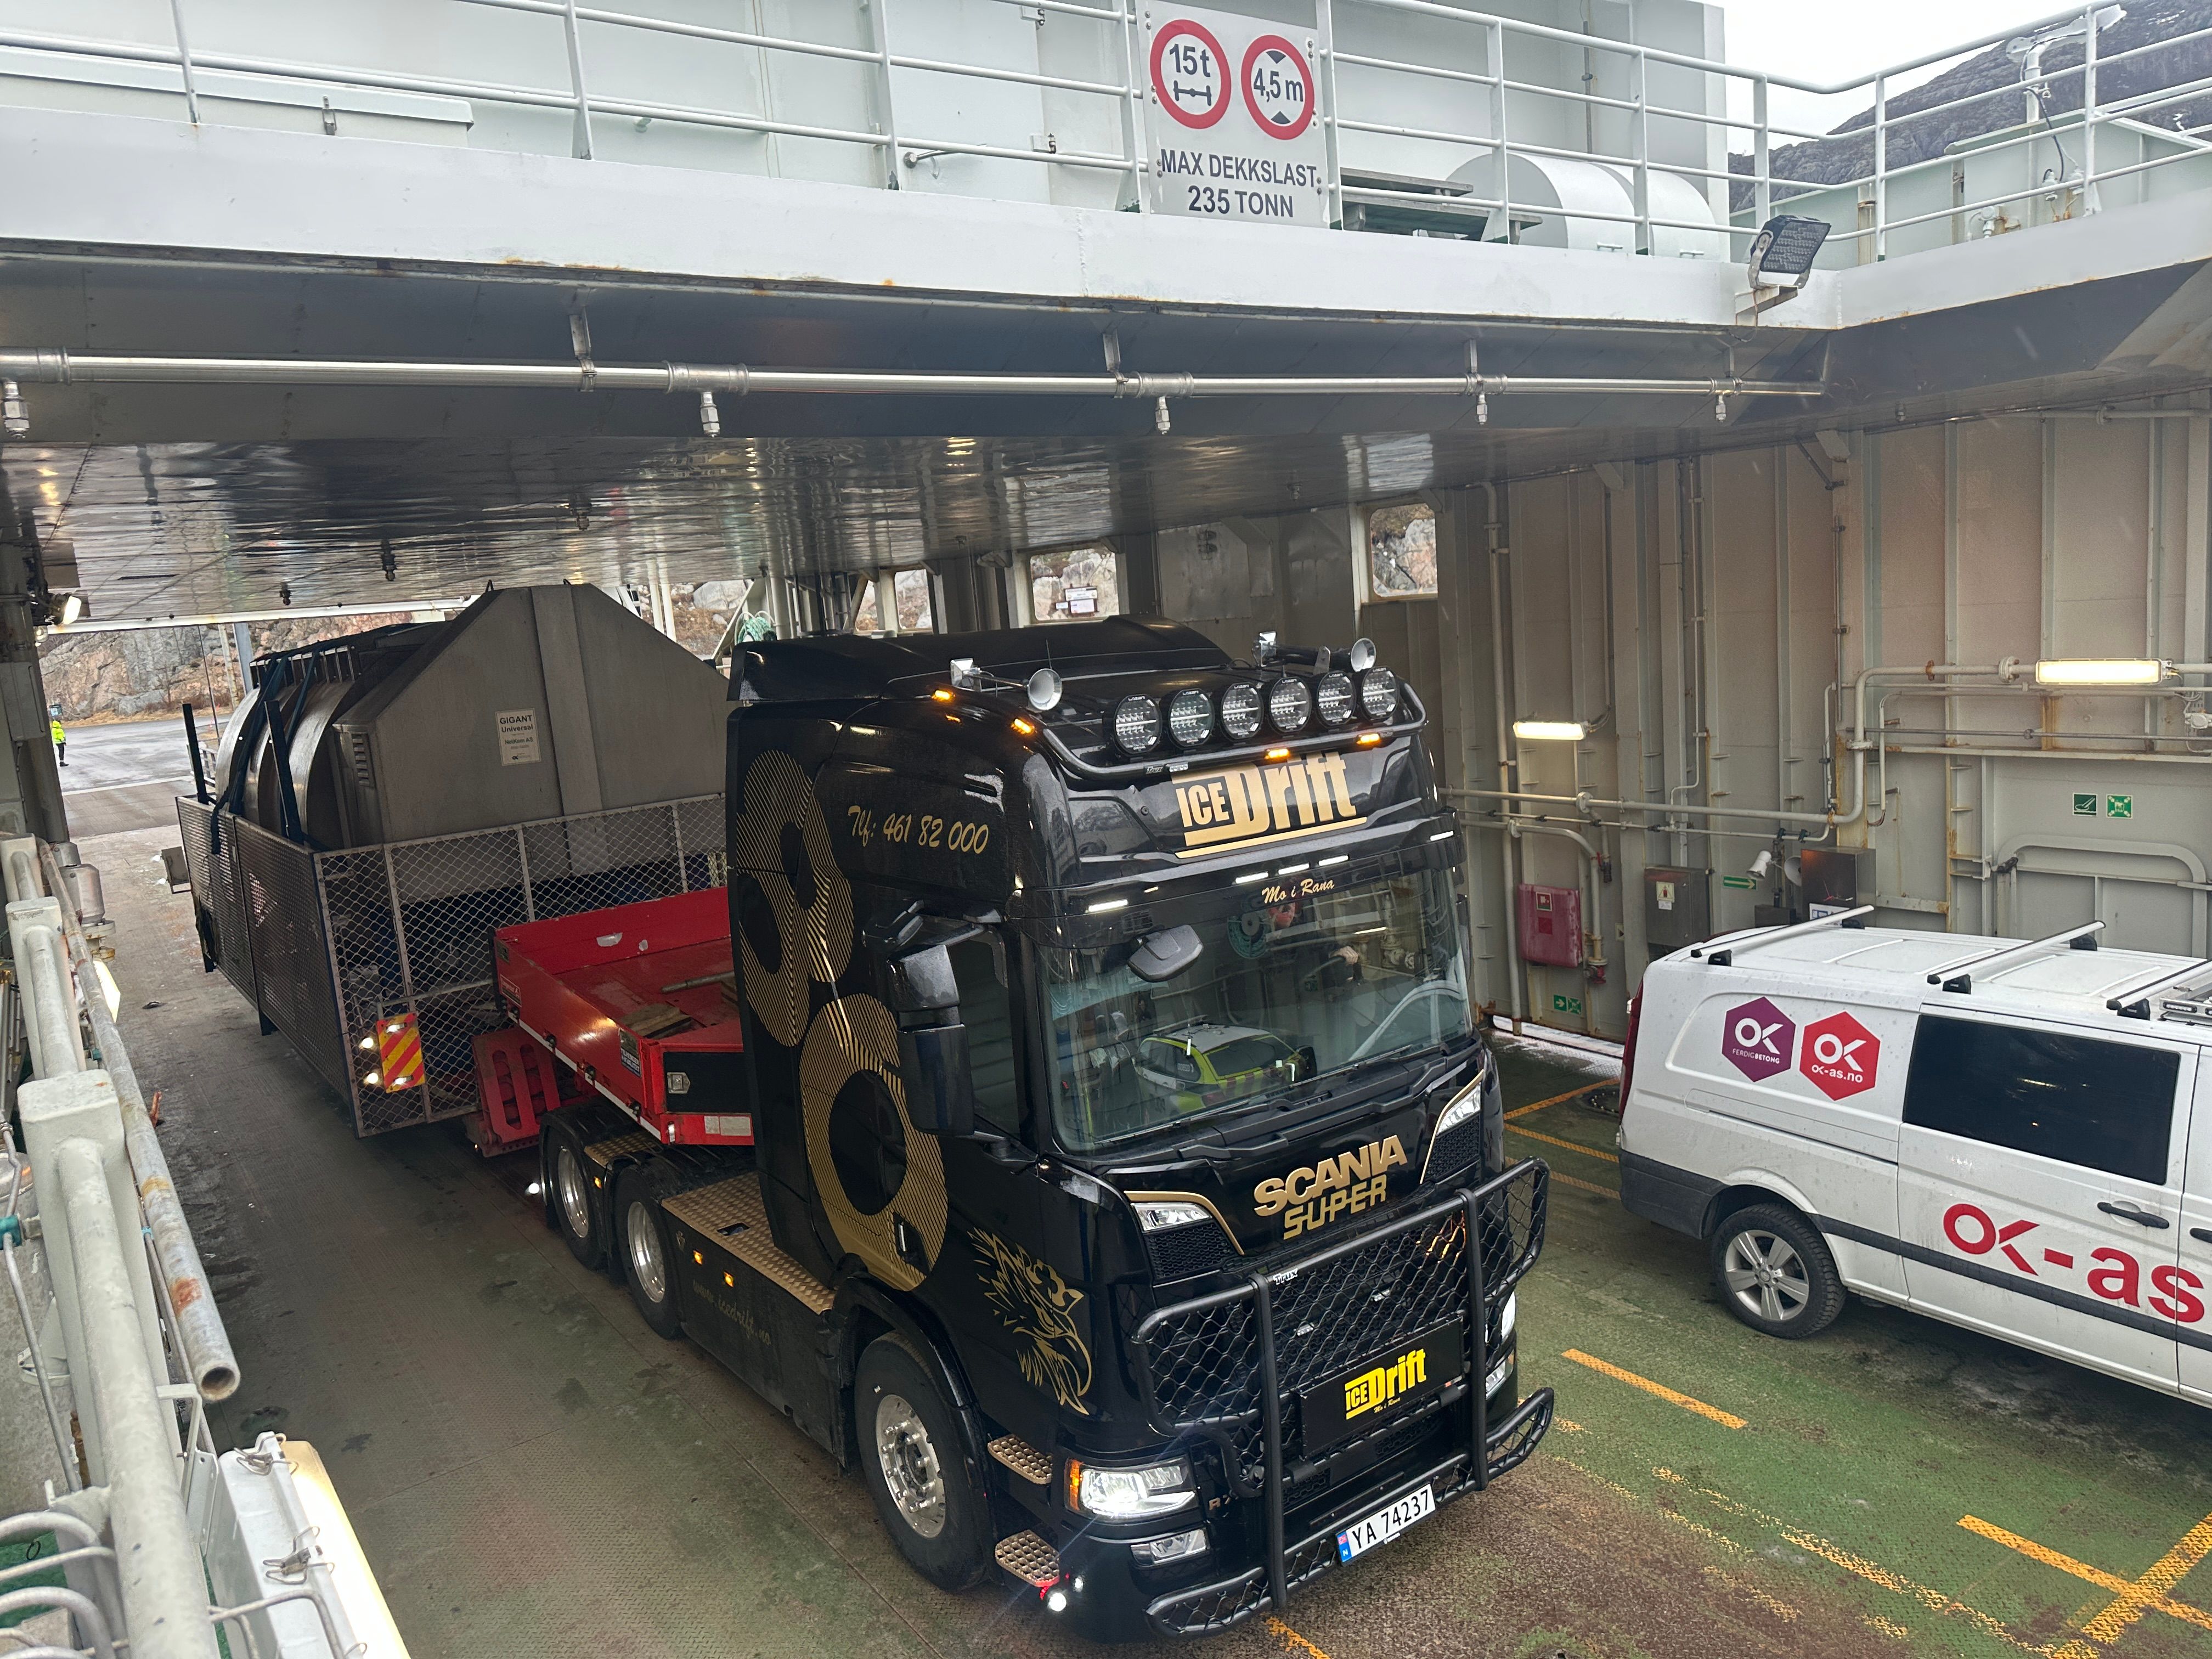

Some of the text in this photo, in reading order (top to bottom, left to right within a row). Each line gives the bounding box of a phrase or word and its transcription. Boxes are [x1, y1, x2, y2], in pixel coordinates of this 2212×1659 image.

[1161, 149, 1317, 188] MAX DEKKSLAST
[1188, 185, 1294, 218] 235 TONN
[499, 714, 533, 724] GIGANT
[501, 724, 534, 733] Universal
[883, 812, 912, 843] 461
[918, 815, 943, 848] 82
[948, 821, 989, 854] 000
[1262, 878, 1335, 904] Mo i Rana
[1735, 1018, 1784, 1054] OK
[1814, 1033, 1867, 1072] OK
[1732, 1048, 1780, 1064] FERDIGBETONG
[1254, 1135, 1408, 1217] SCANIA
[1283, 1174, 1387, 1240] SUPER
[1352, 1488, 1430, 1549] YA 74237
[1342, 1548, 1348, 1557] N
